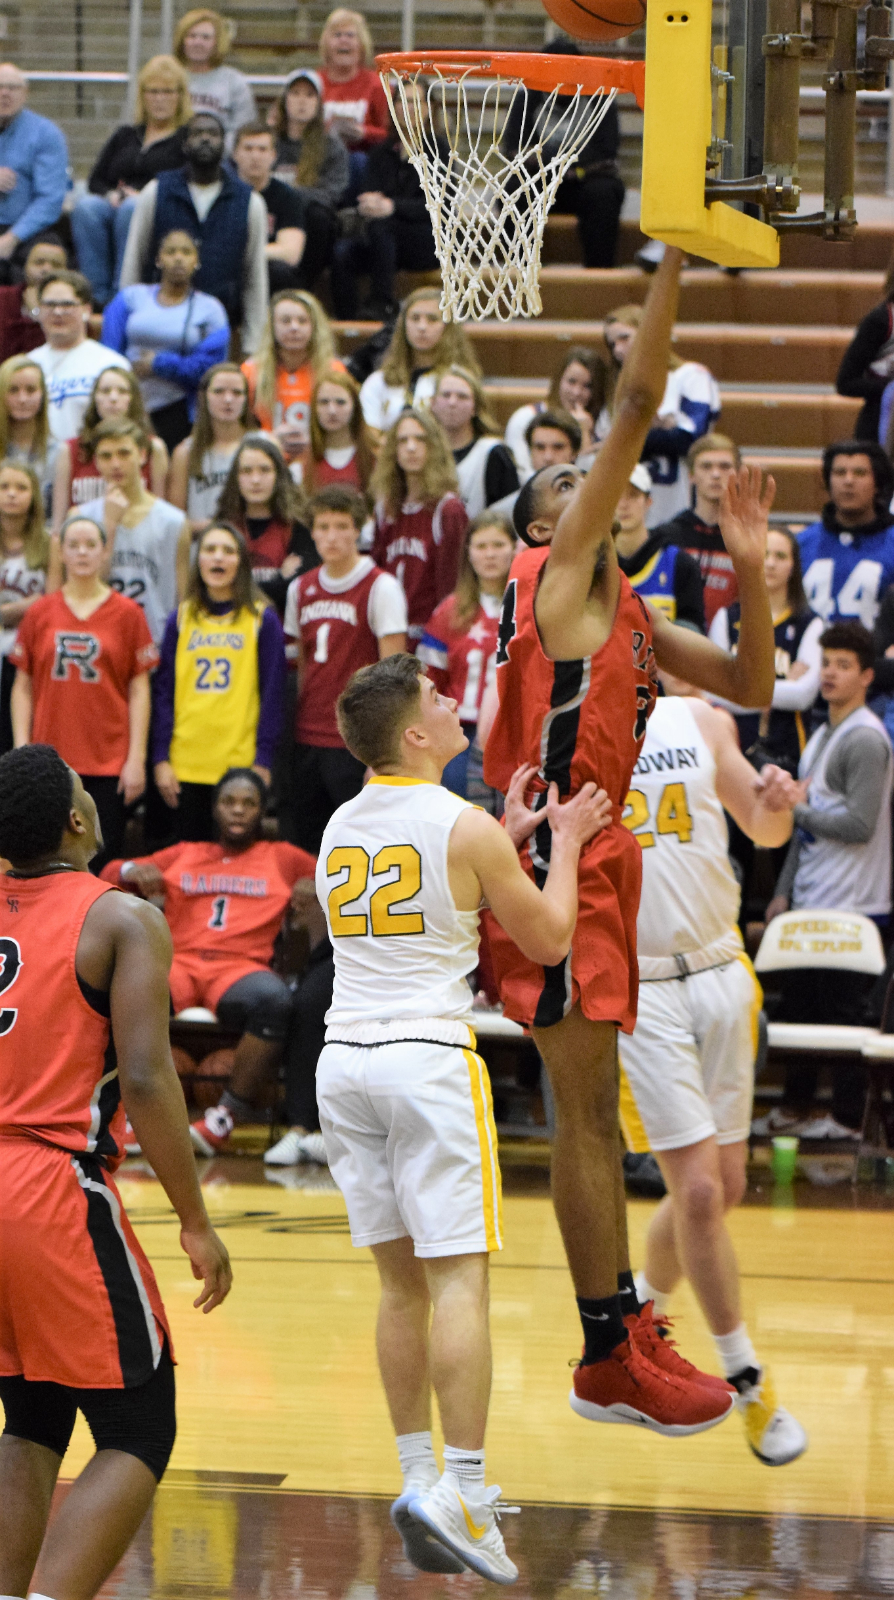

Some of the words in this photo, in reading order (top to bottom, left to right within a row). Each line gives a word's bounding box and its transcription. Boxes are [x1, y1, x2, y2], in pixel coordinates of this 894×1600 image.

[802, 557, 884, 630] 44
[301, 600, 357, 626] INDIANA
[52, 631, 100, 682] R
[188, 629, 245, 651] LAKERS
[314, 622, 330, 663] 1
[195, 657, 232, 692] 23
[633, 747, 699, 775] DWAY
[620, 782, 693, 849] 24
[180, 872, 267, 897] RAIDERS
[326, 843, 425, 938] 22
[207, 895, 230, 931] 1
